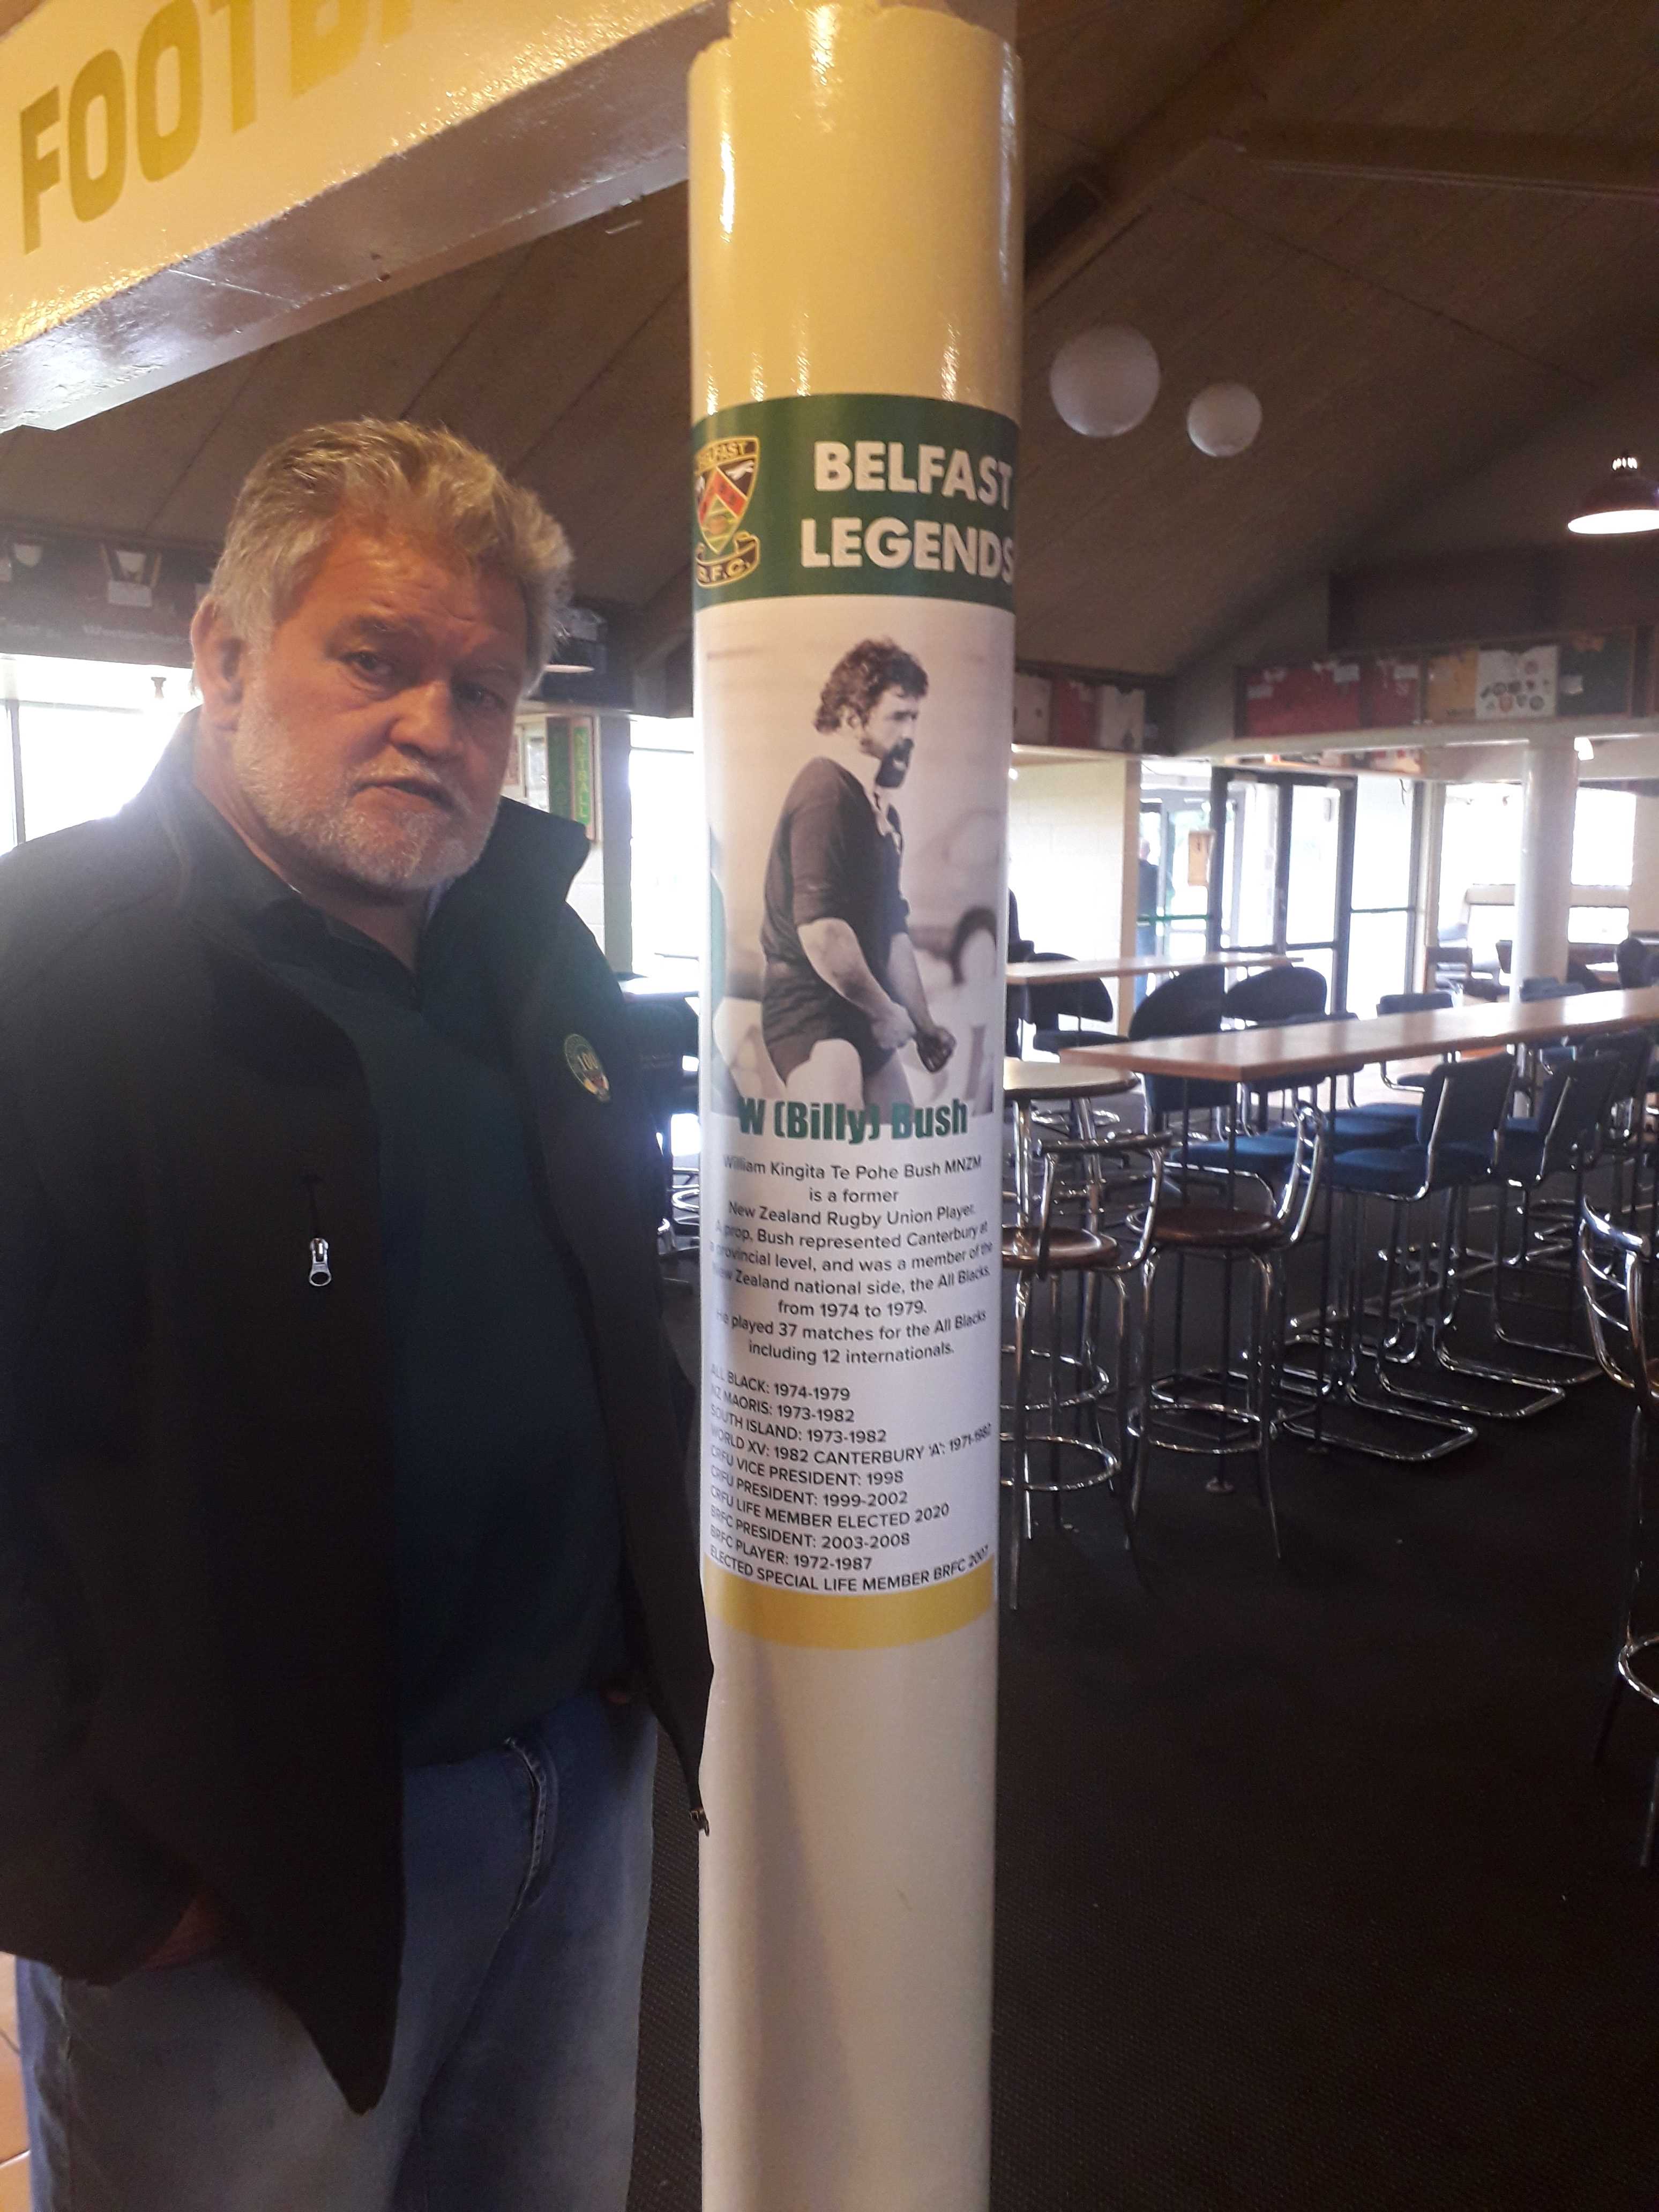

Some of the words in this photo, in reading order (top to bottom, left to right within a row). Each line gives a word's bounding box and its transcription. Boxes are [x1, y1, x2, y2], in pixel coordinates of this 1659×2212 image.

[19, 0, 414, 255] FOOTB
[814, 440, 1013, 510] BELFAST
[801, 517, 1014, 585] LEGENDS
[738, 1098, 765, 1135] W
[775, 1101, 880, 1144] (Billy)
[892, 1099, 967, 1138] Bush
[771, 1162, 825, 1180] Kingita
[831, 1165, 850, 1178] Te
[857, 1165, 899, 1178] Pohe
[905, 1161, 940, 1177] Bush
[945, 1155, 982, 1174] MNZM
[809, 1187, 821, 1201] is
[828, 1191, 836, 1202] a
[843, 1189, 899, 1202] former
[729, 1201, 756, 1218] New
[759, 1206, 820, 1224] Zealand
[828, 1212, 881, 1229] Rugby
[887, 1209, 932, 1224] Union
[758, 1229, 793, 1245] Bush
[799, 1234, 901, 1251] represented
[907, 1225, 978, 1246] Canterbury
[717, 1244, 771, 1265] ovincial
[776, 1254, 817, 1272] level,
[821, 1259, 853, 1272] and
[860, 1261, 893, 1272] was
[898, 1261, 906, 1270] a
[912, 1251, 966, 1269] member
[969, 1245, 980, 1259] of
[735, 1269, 789, 1290] Zealand
[795, 1280, 861, 1295] national
[866, 1280, 905, 1295] side,
[910, 1277, 934, 1291] the
[938, 1272, 954, 1287] All
[778, 1299, 814, 1315] from
[820, 1304, 860, 1317] 1974
[865, 1304, 881, 1317] to
[888, 1299, 928, 1316] 1979.
[732, 1315, 773, 1334] played
[779, 1323, 797, 1336] 37
[803, 1327, 873, 1340] matches
[879, 1326, 901, 1339] for
[906, 1324, 930, 1338] the
[934, 1319, 951, 1333] All
[749, 1340, 816, 1365] including
[822, 1349, 841, 1363] 12
[847, 1341, 954, 1364] internationals.
[728, 1371, 769, 1394] BLACK:
[774, 1382, 850, 1401] 1974-1979
[724, 1391, 773, 1415] MAORIS:
[777, 1404, 855, 1423] 1973-1982
[712, 1403, 743, 1430] SOUTH
[746, 1419, 802, 1441] ISLAND:
[807, 1428, 887, 1444] 1973-1982
[712, 1445, 734, 1467] CRFU
[736, 1457, 765, 1476] VICE
[769, 1466, 861, 1486] PRESIDENT:
[867, 1470, 904, 1485] 1998
[748, 1439, 769, 1456] XV:
[775, 1446, 809, 1462] 1982
[813, 1445, 924, 1465] CANTERBURY
[712, 1465, 734, 1487] CRFU
[737, 1478, 818, 1506] PRESIDENT:
[824, 1490, 908, 1507] 1999-2002
[711, 1485, 734, 1507] CRFU
[737, 1499, 761, 1518] LIFE
[765, 1507, 832, 1527] MEMBER
[838, 1512, 910, 1528] ELECTED
[915, 1502, 949, 1523] 2020
[711, 1505, 733, 1528] BRFC
[736, 1519, 816, 1548] PRESIDENT:
[821, 1533, 910, 1549] 2003-2008
[711, 1525, 733, 1549] BRFC
[736, 1539, 789, 1565] PLAYER:
[794, 1555, 872, 1571] 1972-1987
[711, 1544, 753, 1576] ELECTED
[757, 1567, 818, 1590] SPECIAL
[824, 1578, 857, 1591] LIFE
[862, 1570, 930, 1591] MEMBER
[933, 1559, 966, 1581] BRFC
